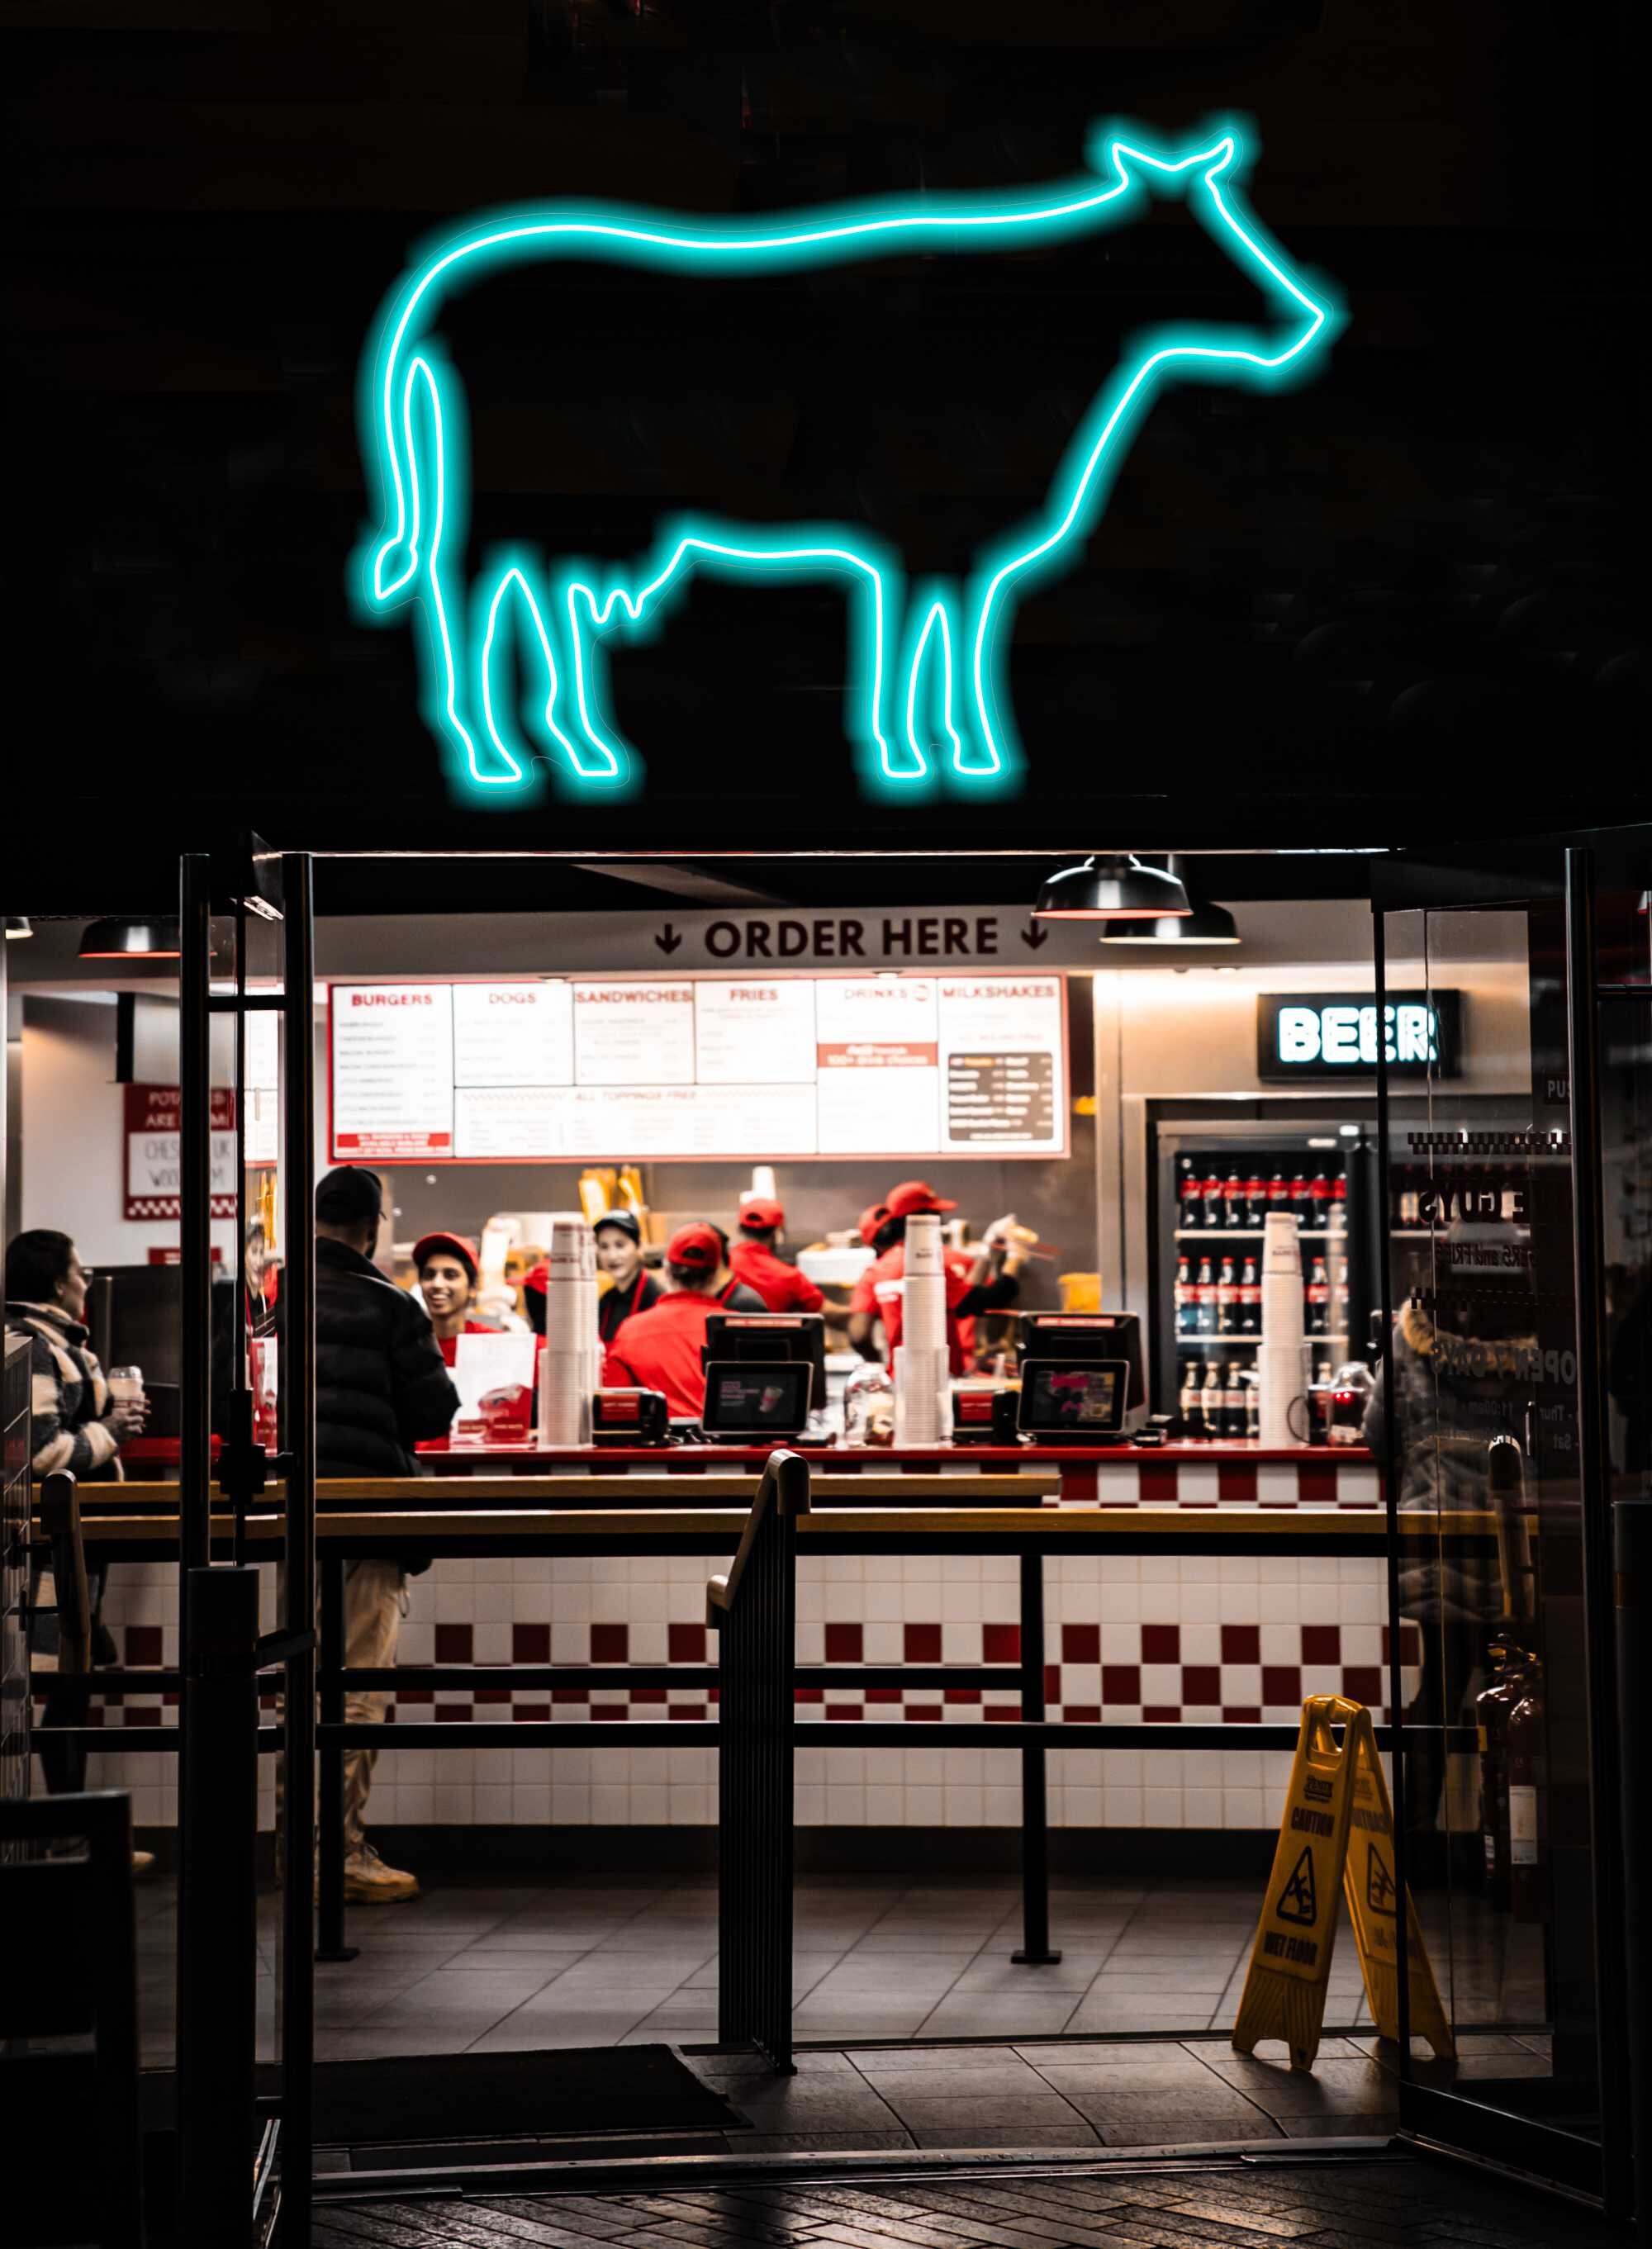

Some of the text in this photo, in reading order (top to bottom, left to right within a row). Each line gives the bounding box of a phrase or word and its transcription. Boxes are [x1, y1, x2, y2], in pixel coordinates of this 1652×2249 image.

[705, 918, 998, 957] ORDER HERE
[488, 991, 537, 1004] DOGS
[575, 989, 693, 1004] SANDWICHES
[729, 988, 778, 1002] FRIES
[844, 988, 909, 1000] DRINKS
[942, 985, 1056, 999] MILKSHAKES
[351, 993, 434, 1007] BURGERS
[1279, 1005, 1437, 1063] BEER
[1291, 1806, 1335, 1837] CAUTION
